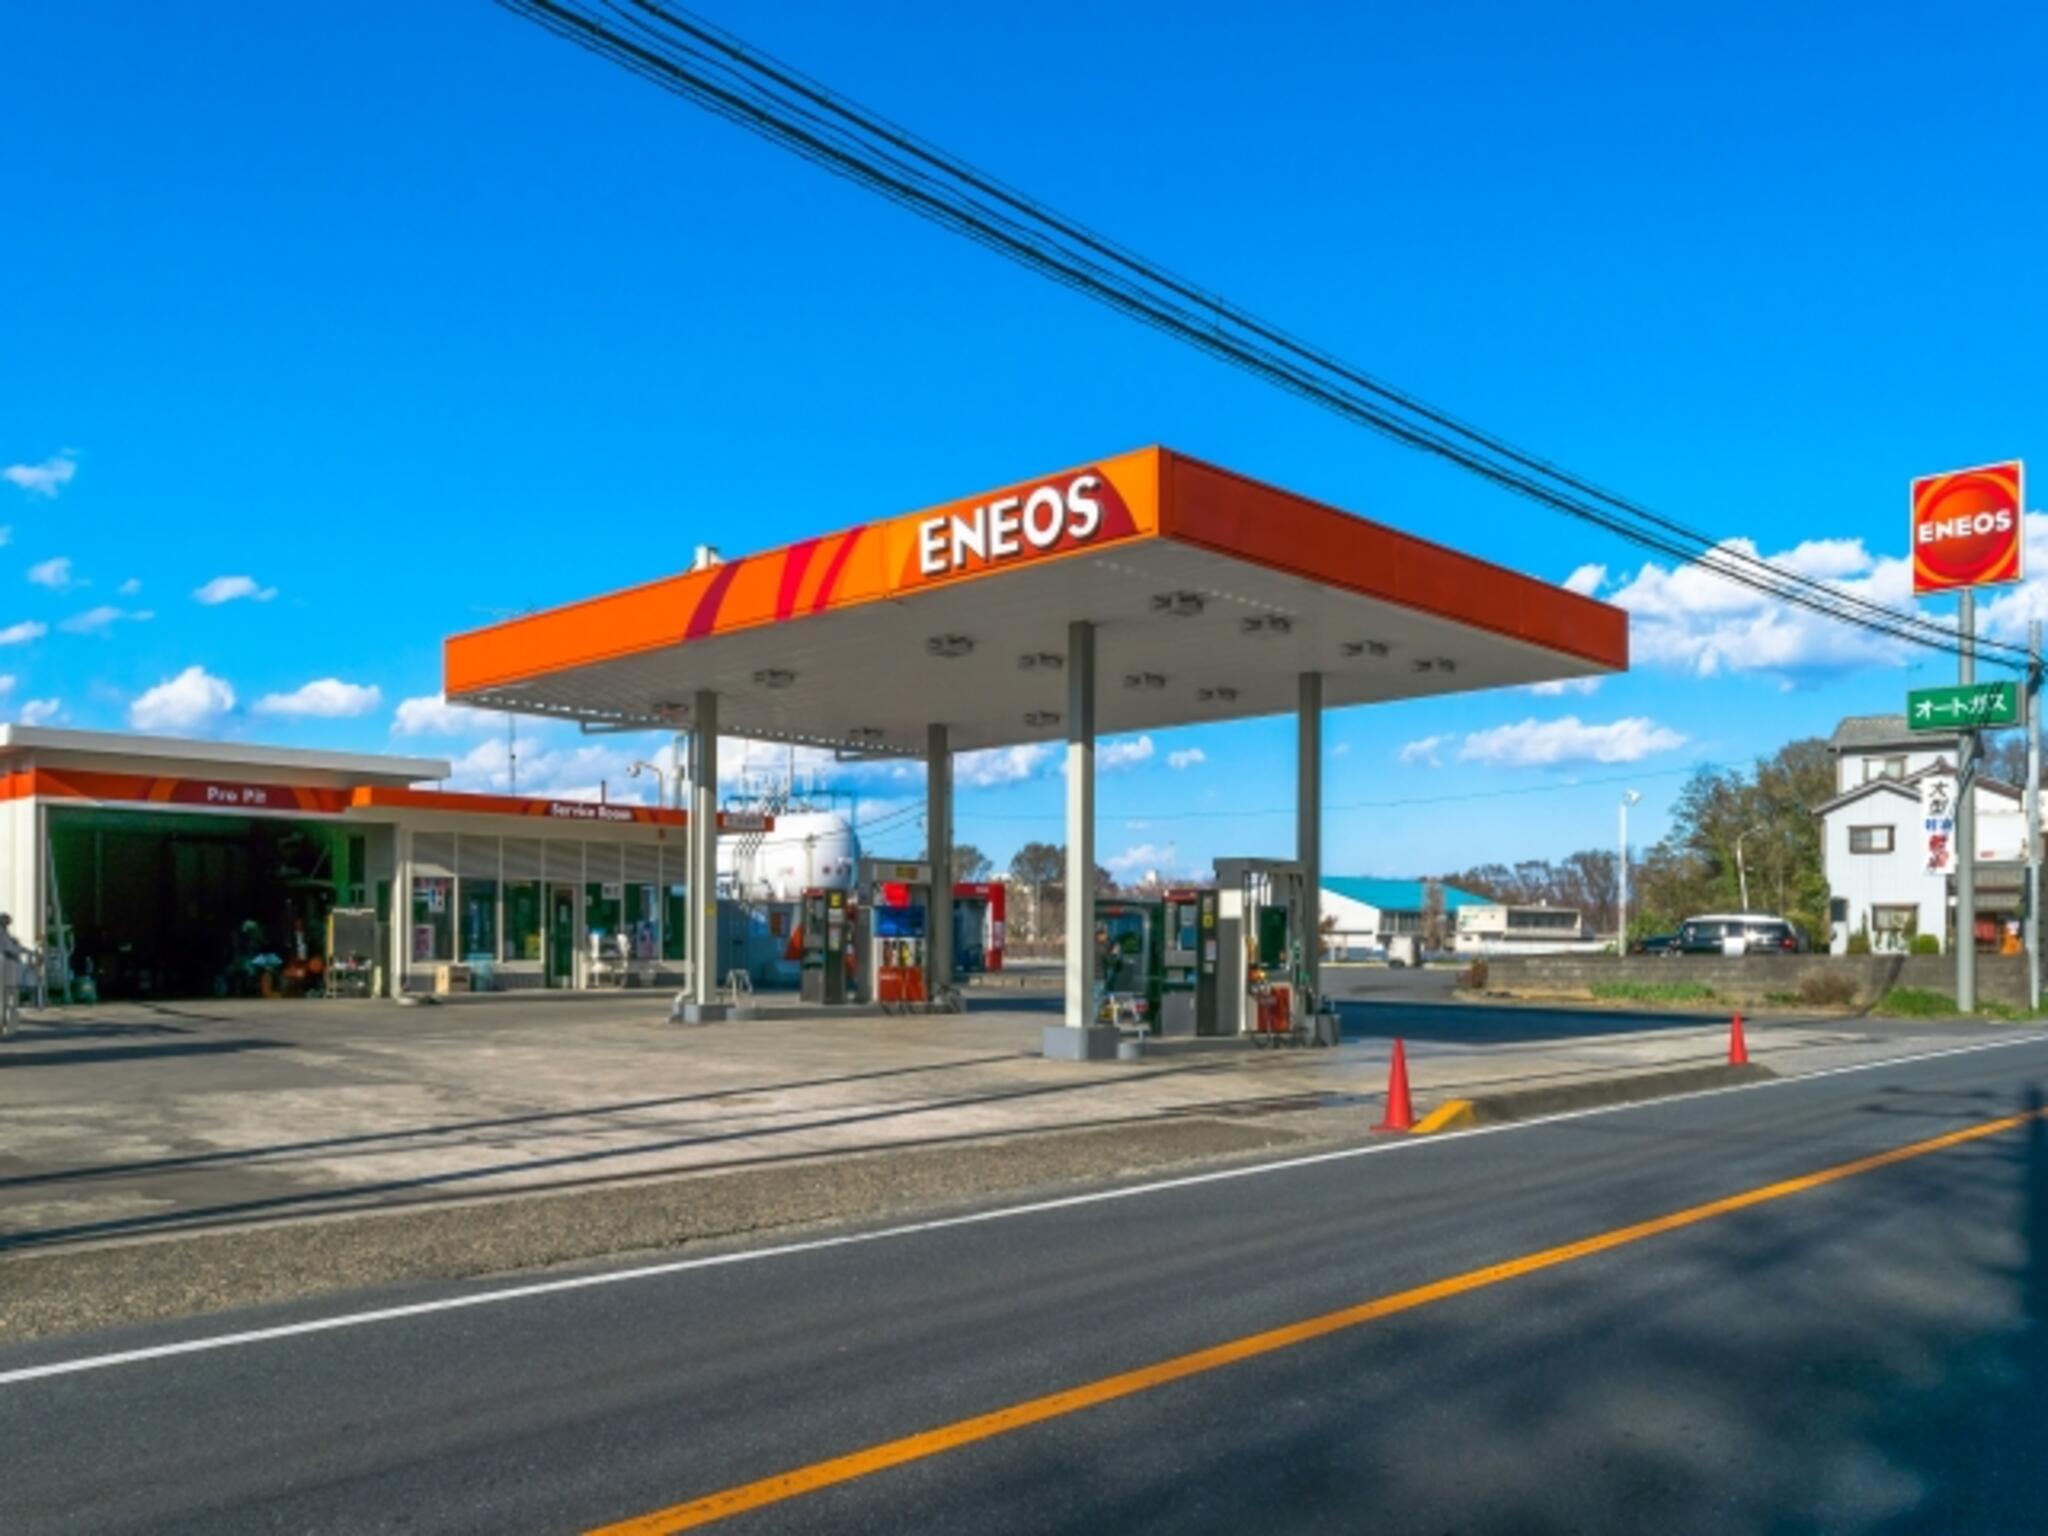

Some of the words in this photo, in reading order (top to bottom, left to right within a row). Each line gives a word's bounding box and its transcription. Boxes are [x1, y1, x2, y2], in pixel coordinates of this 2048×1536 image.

[919, 475, 1099, 575] ENEOS
[1918, 508, 2012, 543] ENEOS
[1915, 692, 2007, 720] オートガス
[207, 786, 238, 802] Pro
